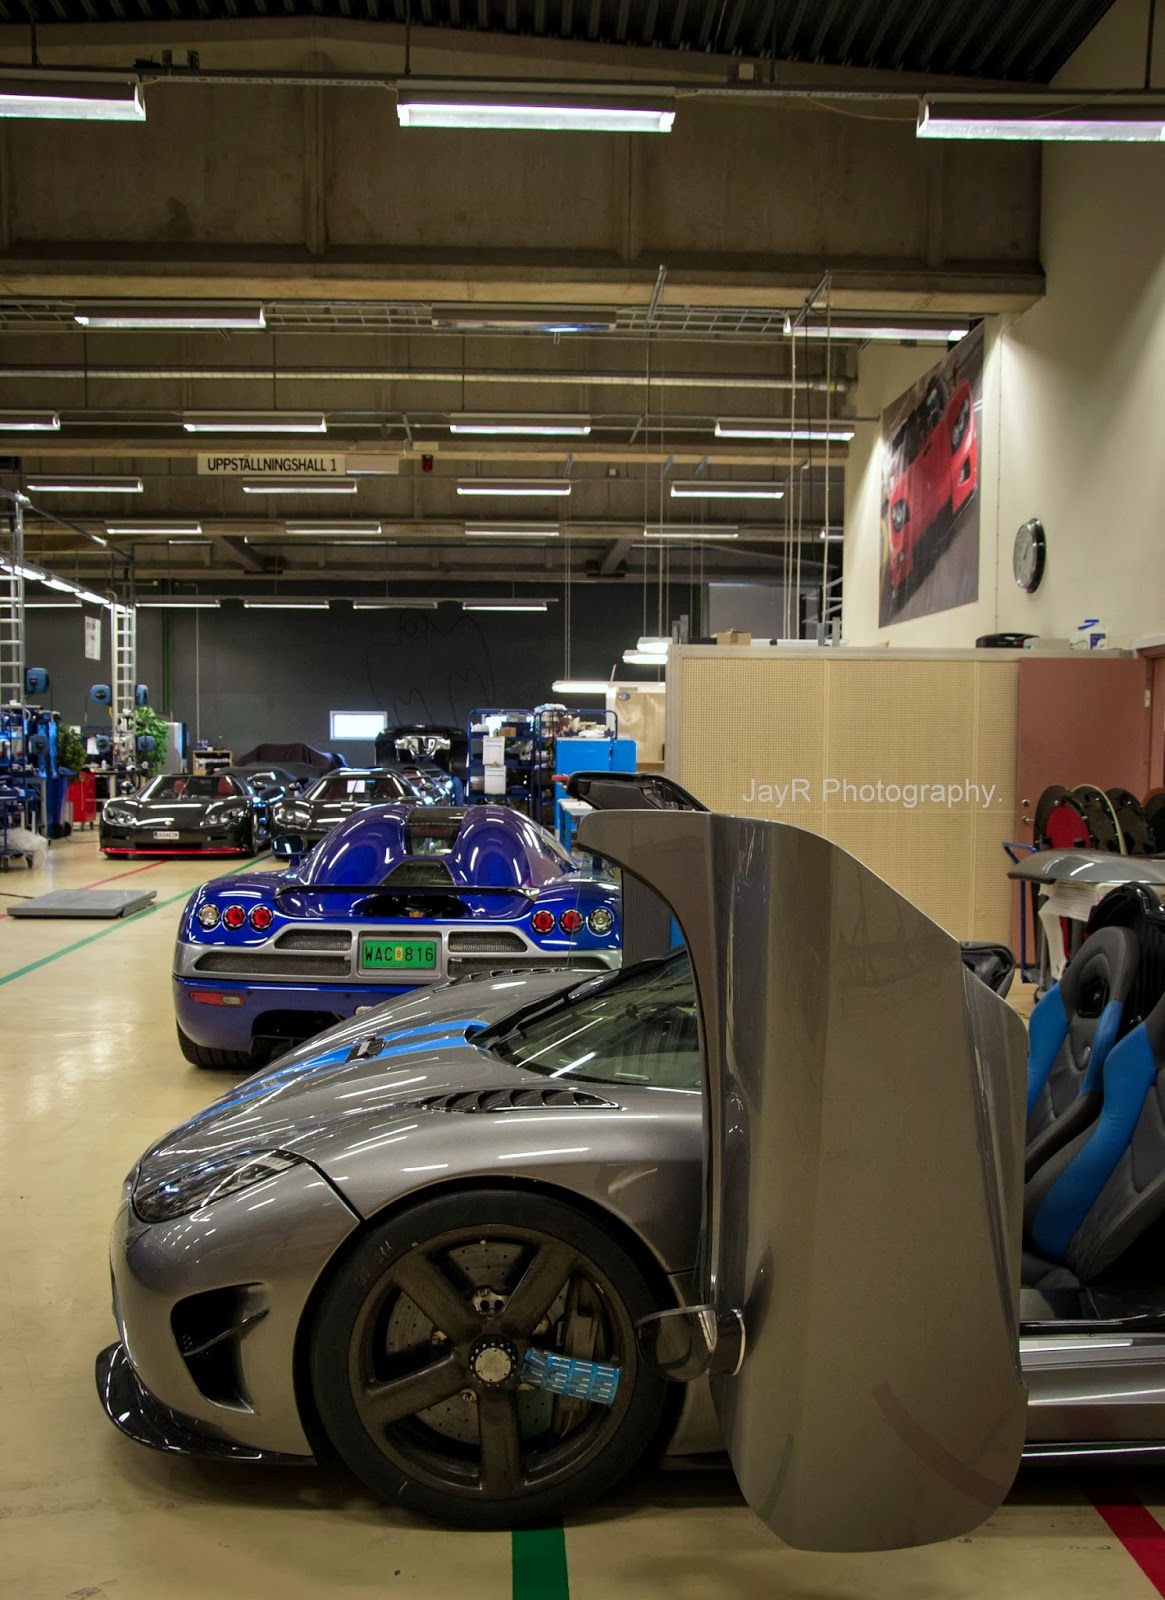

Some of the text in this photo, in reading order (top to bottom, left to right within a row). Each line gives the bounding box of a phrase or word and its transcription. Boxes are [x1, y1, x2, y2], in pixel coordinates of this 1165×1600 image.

[207, 455, 337, 472] UPPSTÄLLNINGSHALL 1
[365, 947, 393, 962] WAC
[405, 947, 434, 962] 816
